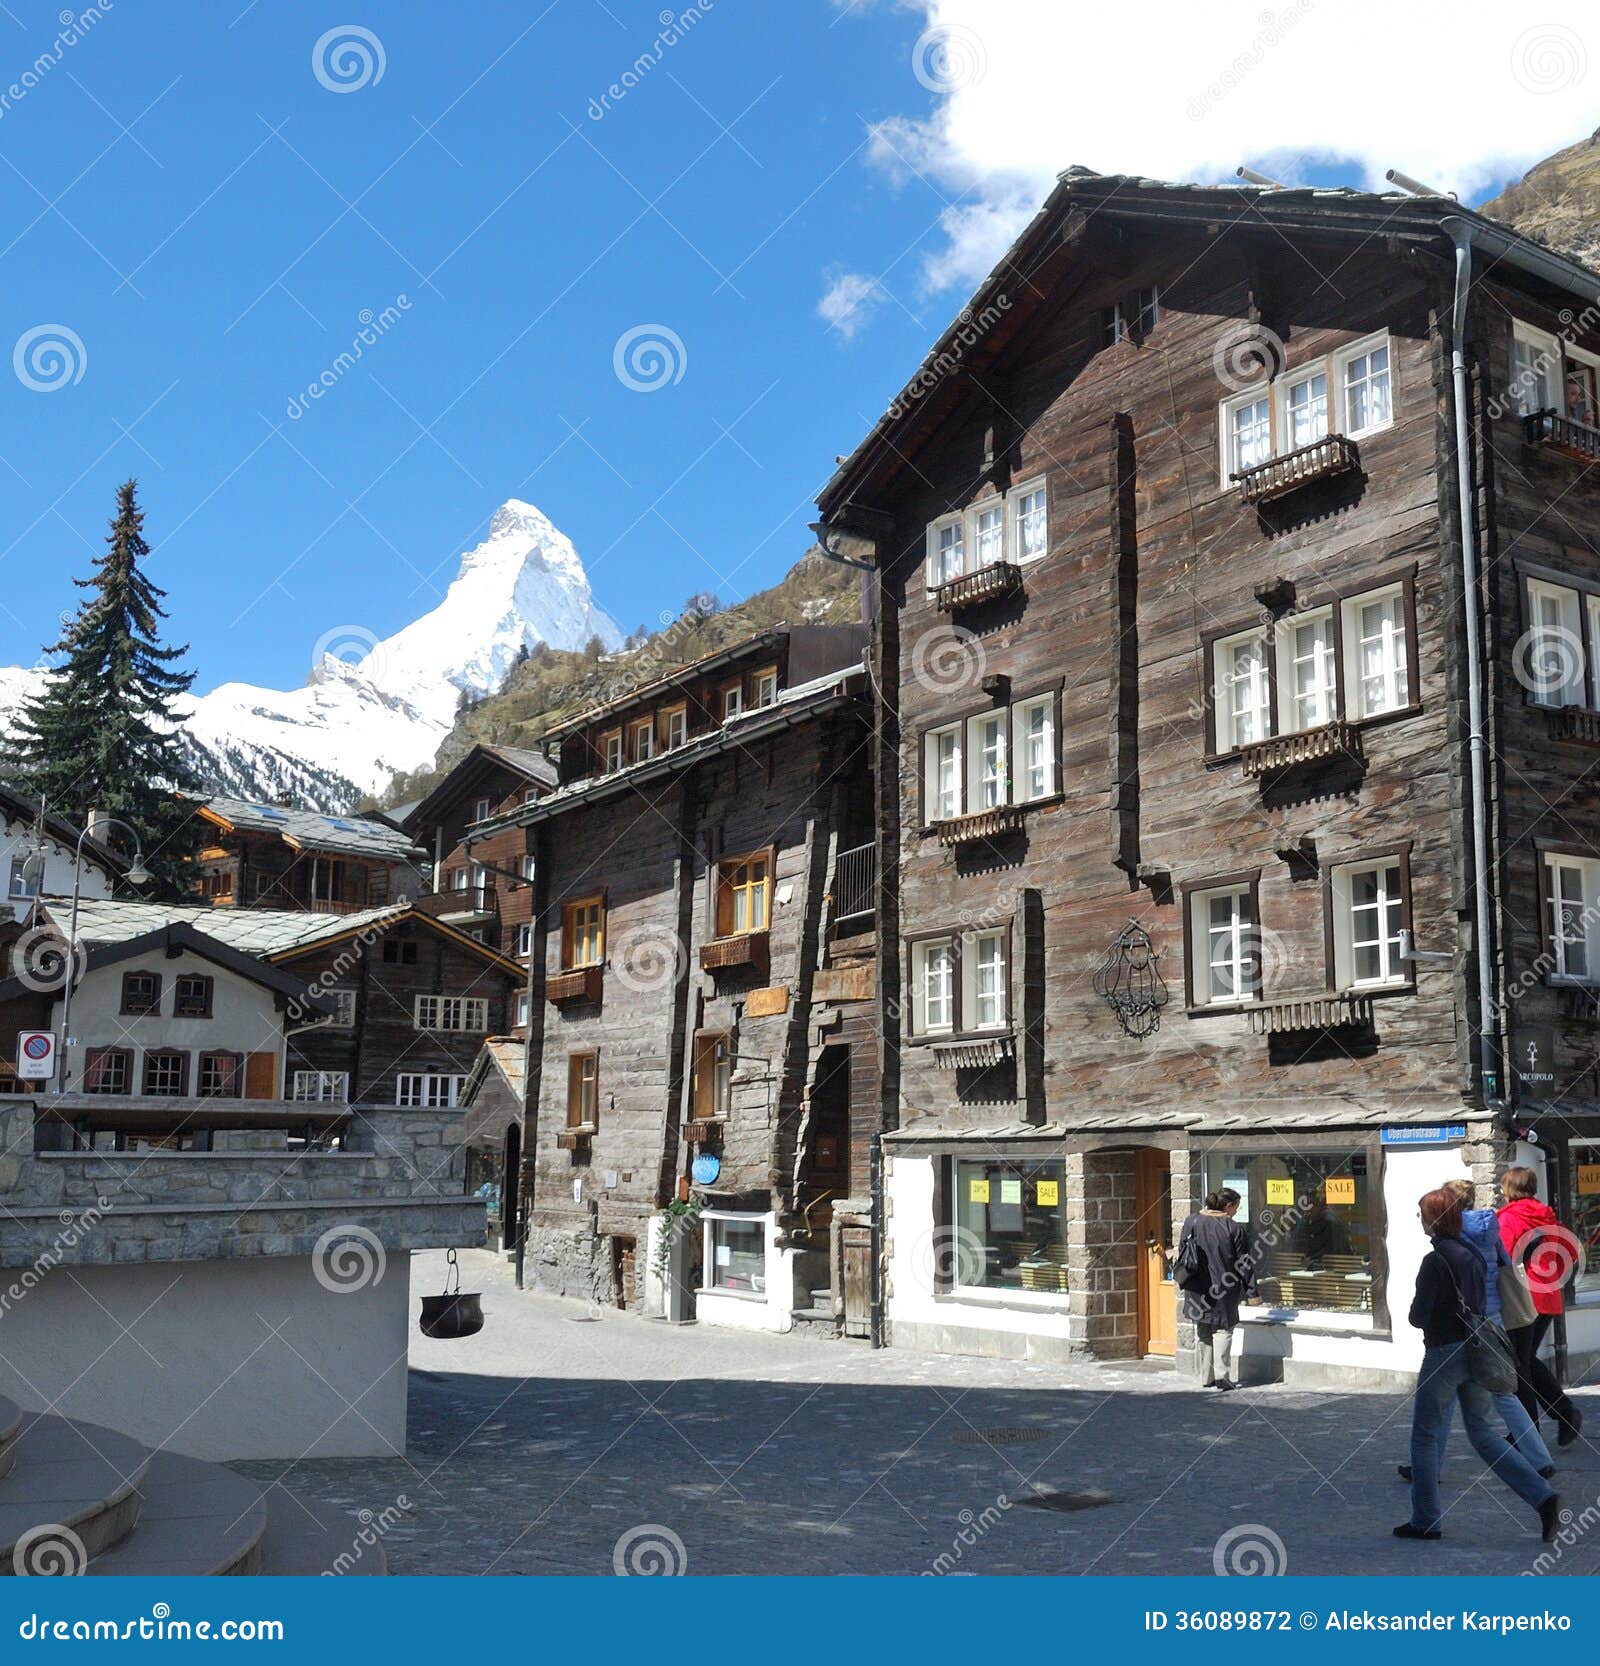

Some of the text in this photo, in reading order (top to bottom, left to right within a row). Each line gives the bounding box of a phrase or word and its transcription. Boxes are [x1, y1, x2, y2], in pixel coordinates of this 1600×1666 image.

[1039, 1186, 1057, 1198] SALE
[1271, 1183, 1290, 1195] 20%
[1327, 1182, 1353, 1193] SALE
